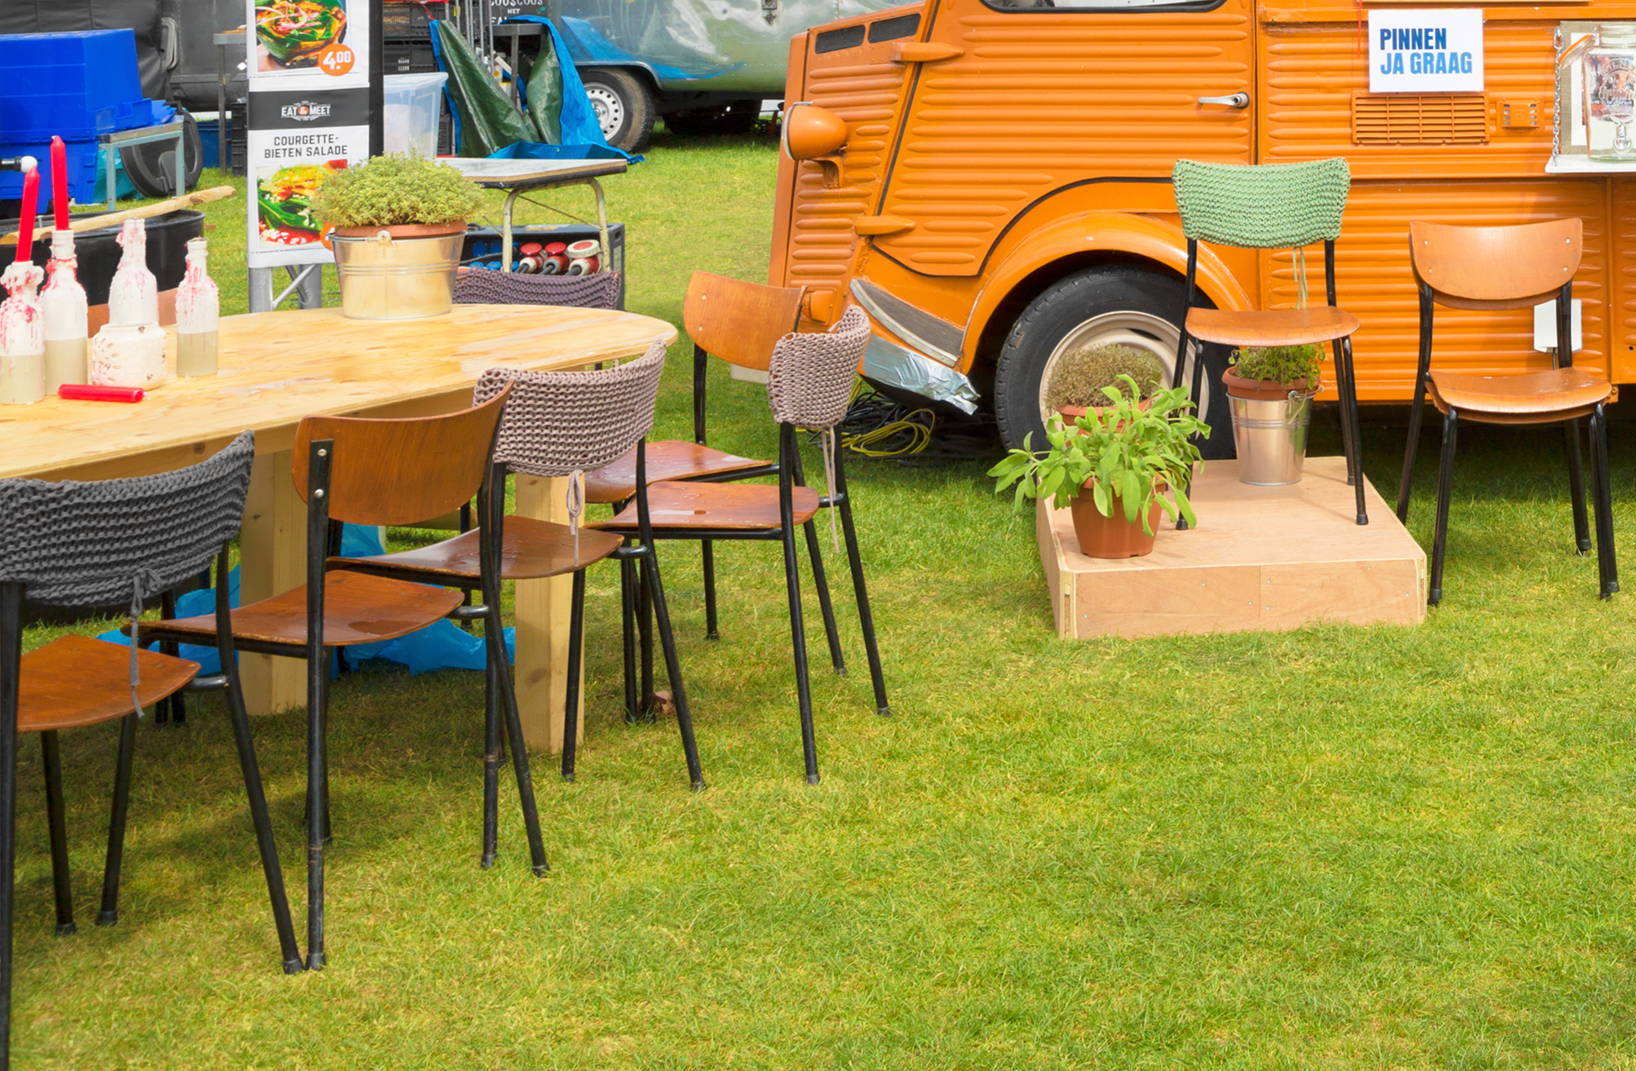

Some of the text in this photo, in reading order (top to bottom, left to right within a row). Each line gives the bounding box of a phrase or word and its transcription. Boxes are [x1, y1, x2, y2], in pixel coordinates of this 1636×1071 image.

[1380, 28, 1447, 50] PINNEN
[322, 51, 352, 70] 4.00
[1380, 52, 1473, 75] JA GRAAG
[281, 107, 298, 117] EAT
[309, 106, 331, 115] MEET
[274, 134, 339, 146] COURGETTE-
[264, 145, 348, 159] BIETEN SALADE
